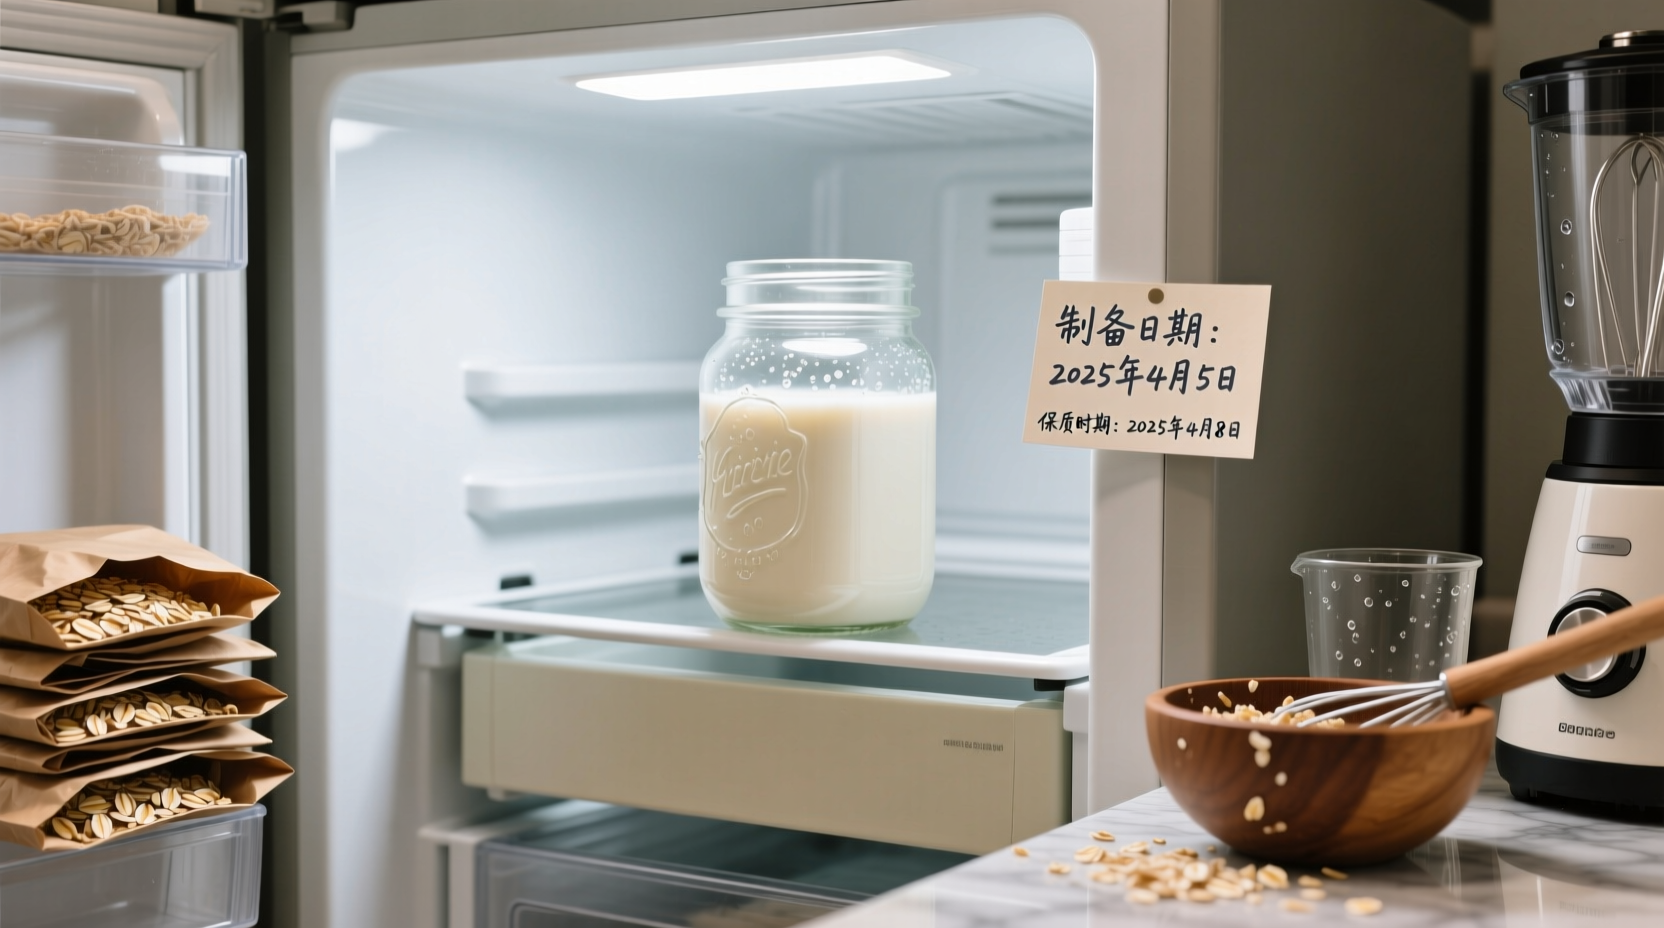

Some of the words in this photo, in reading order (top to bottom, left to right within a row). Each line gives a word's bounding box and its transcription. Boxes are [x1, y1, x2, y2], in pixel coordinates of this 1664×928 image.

[1055, 304, 1219, 348] 制备日期：
[1049, 354, 1236, 396] 2025年4月5日
